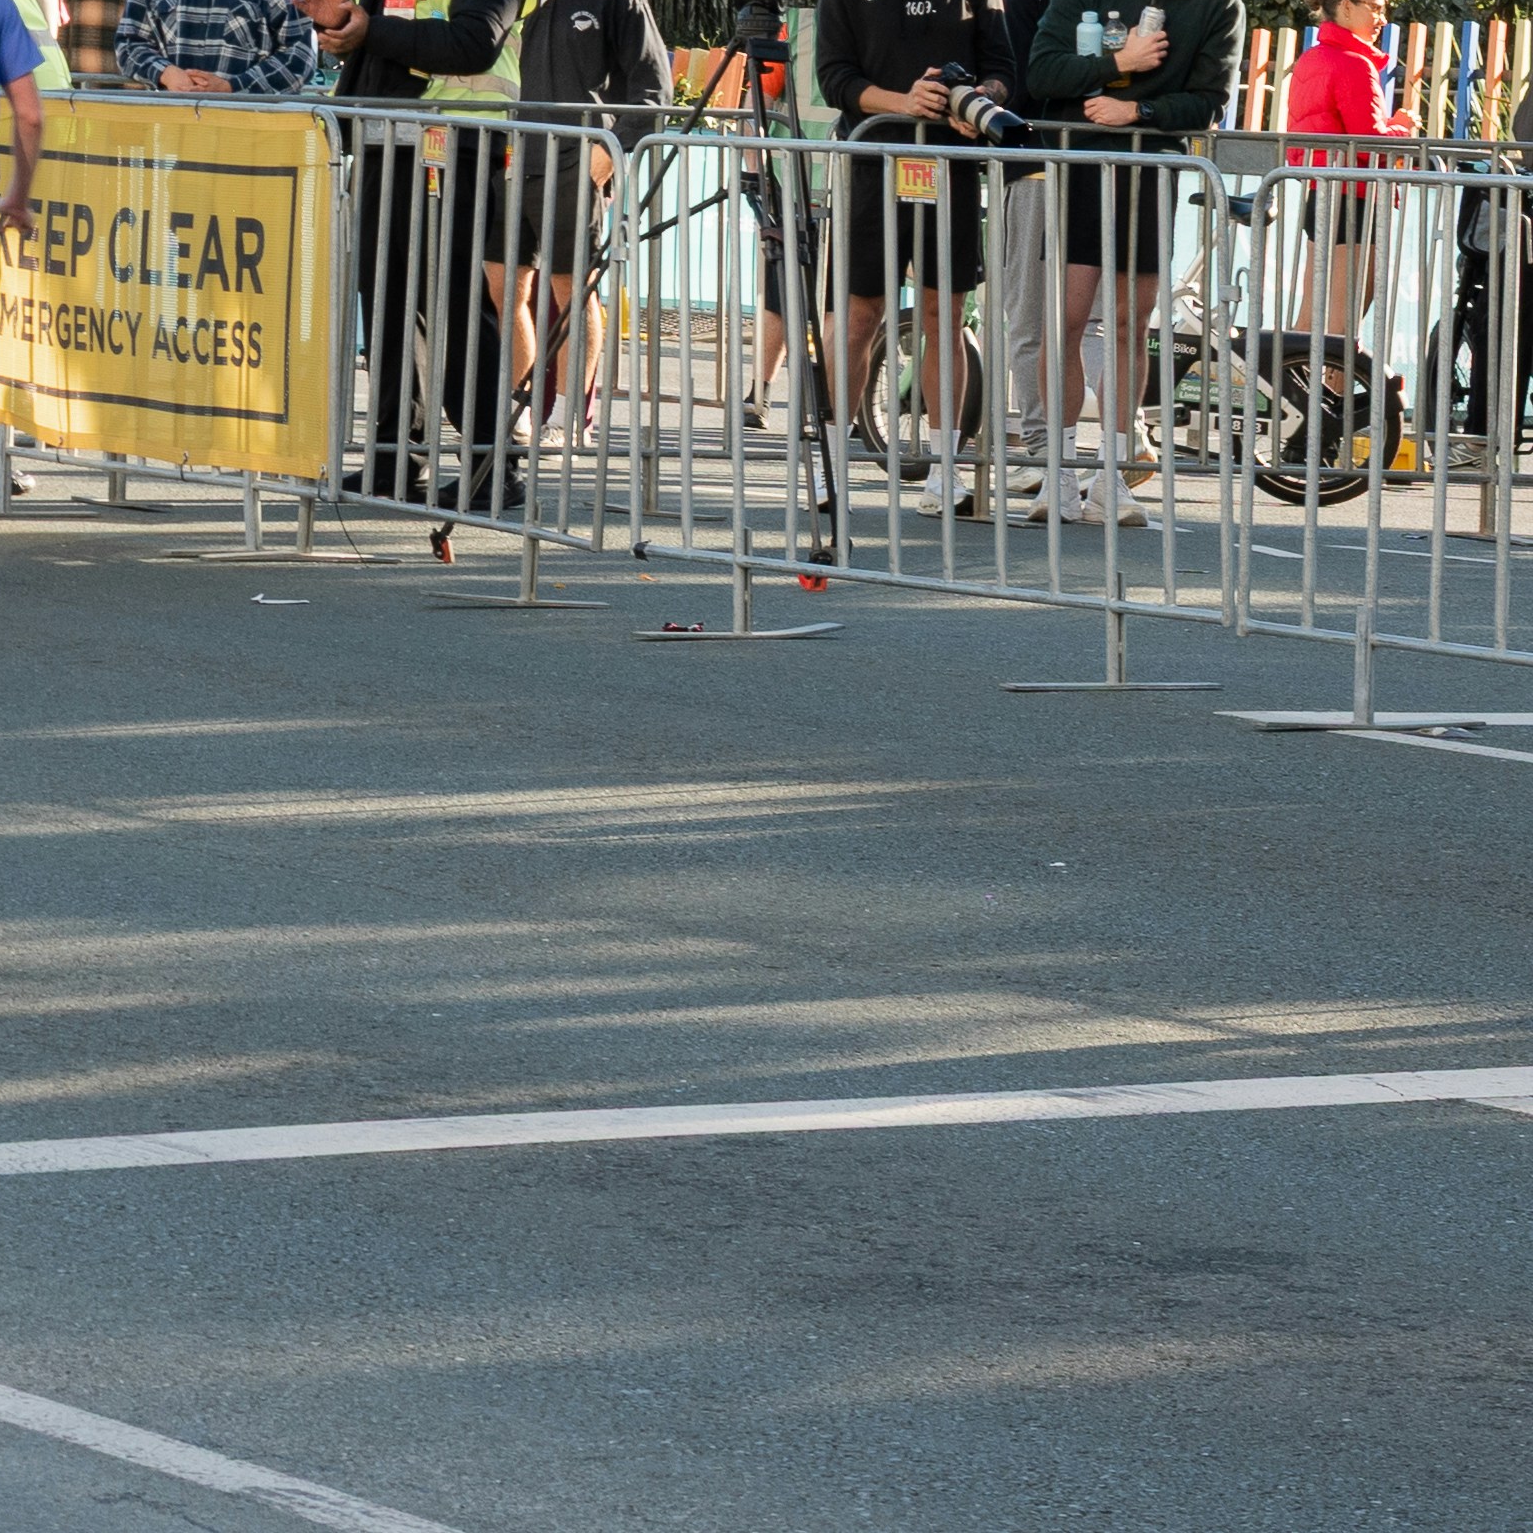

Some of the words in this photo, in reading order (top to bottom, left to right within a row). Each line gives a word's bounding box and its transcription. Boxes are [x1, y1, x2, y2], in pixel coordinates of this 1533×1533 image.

[901, 163, 934, 187] TFH
[108, 207, 266, 295] CLEAR
[151, 313, 263, 369] ACCESS
[1173, 342, 1198, 355] Bike
